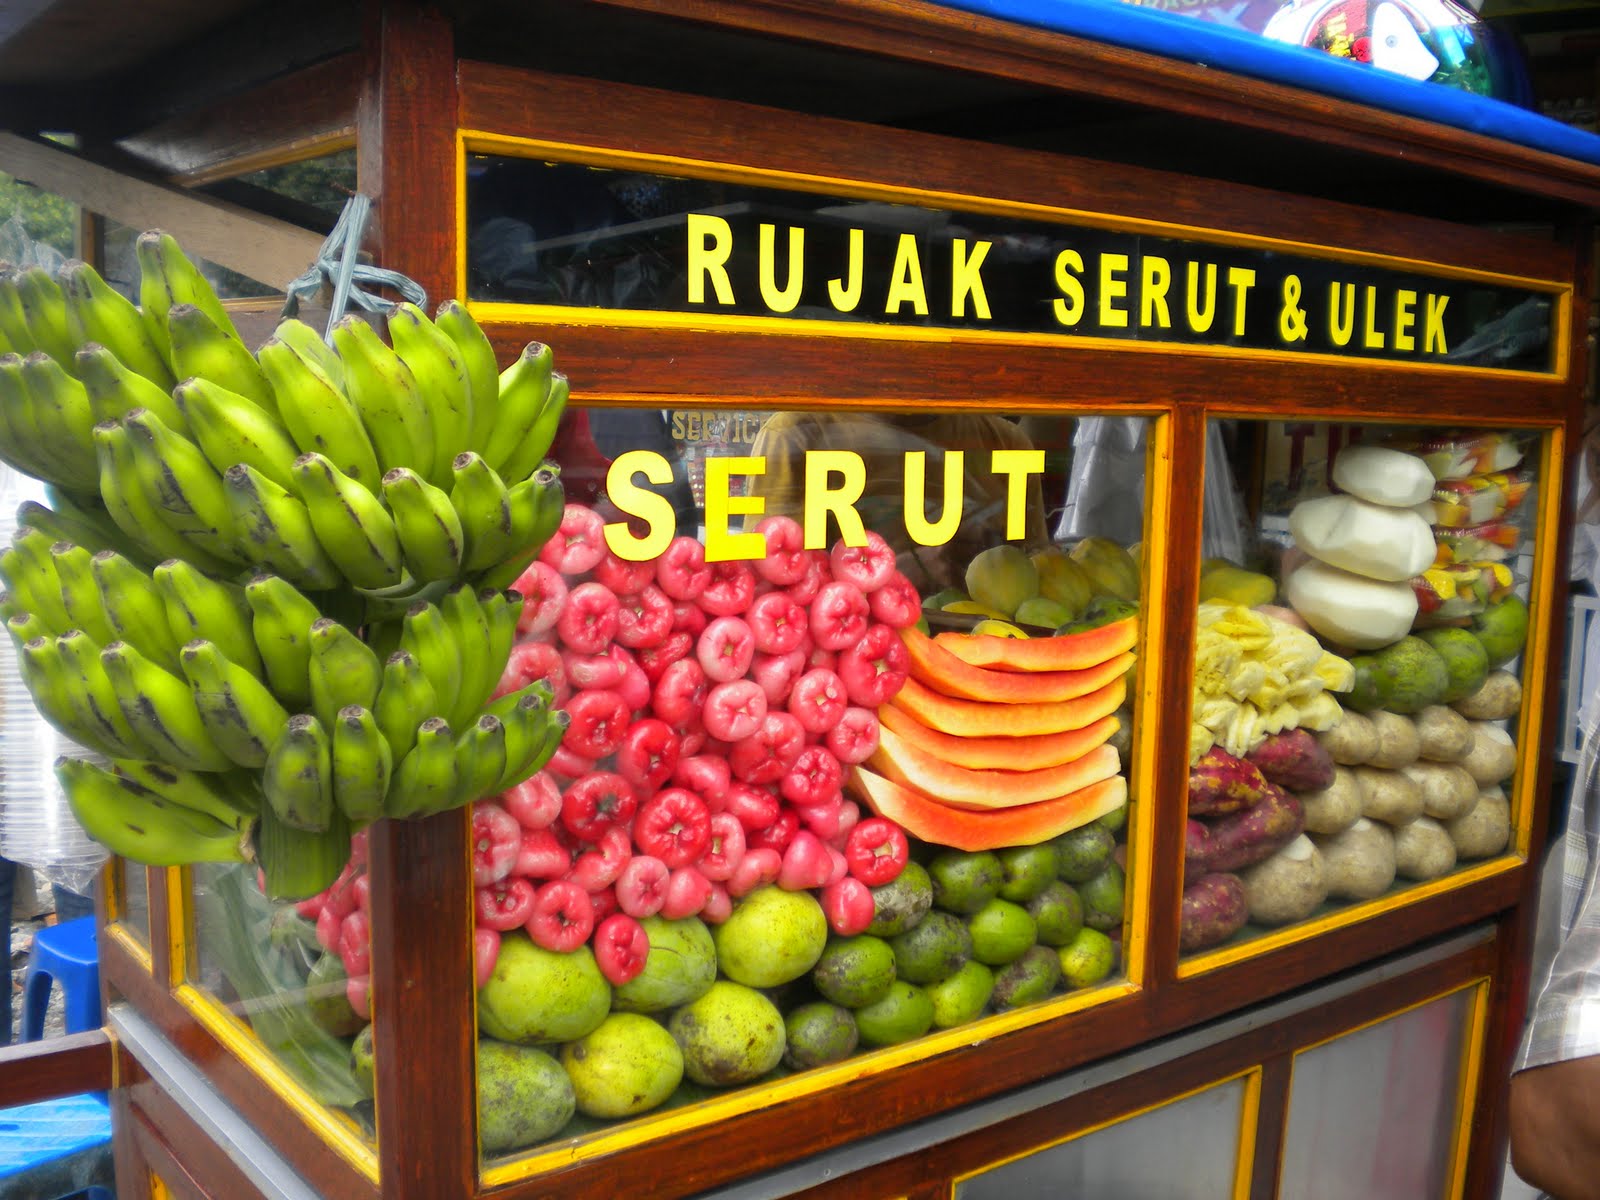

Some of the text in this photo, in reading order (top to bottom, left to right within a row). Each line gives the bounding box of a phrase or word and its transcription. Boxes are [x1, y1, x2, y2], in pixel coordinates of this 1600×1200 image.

[687, 213, 1450, 355] RUJAK SERUT & ULEK
[603, 449, 1046, 562] SERUT
